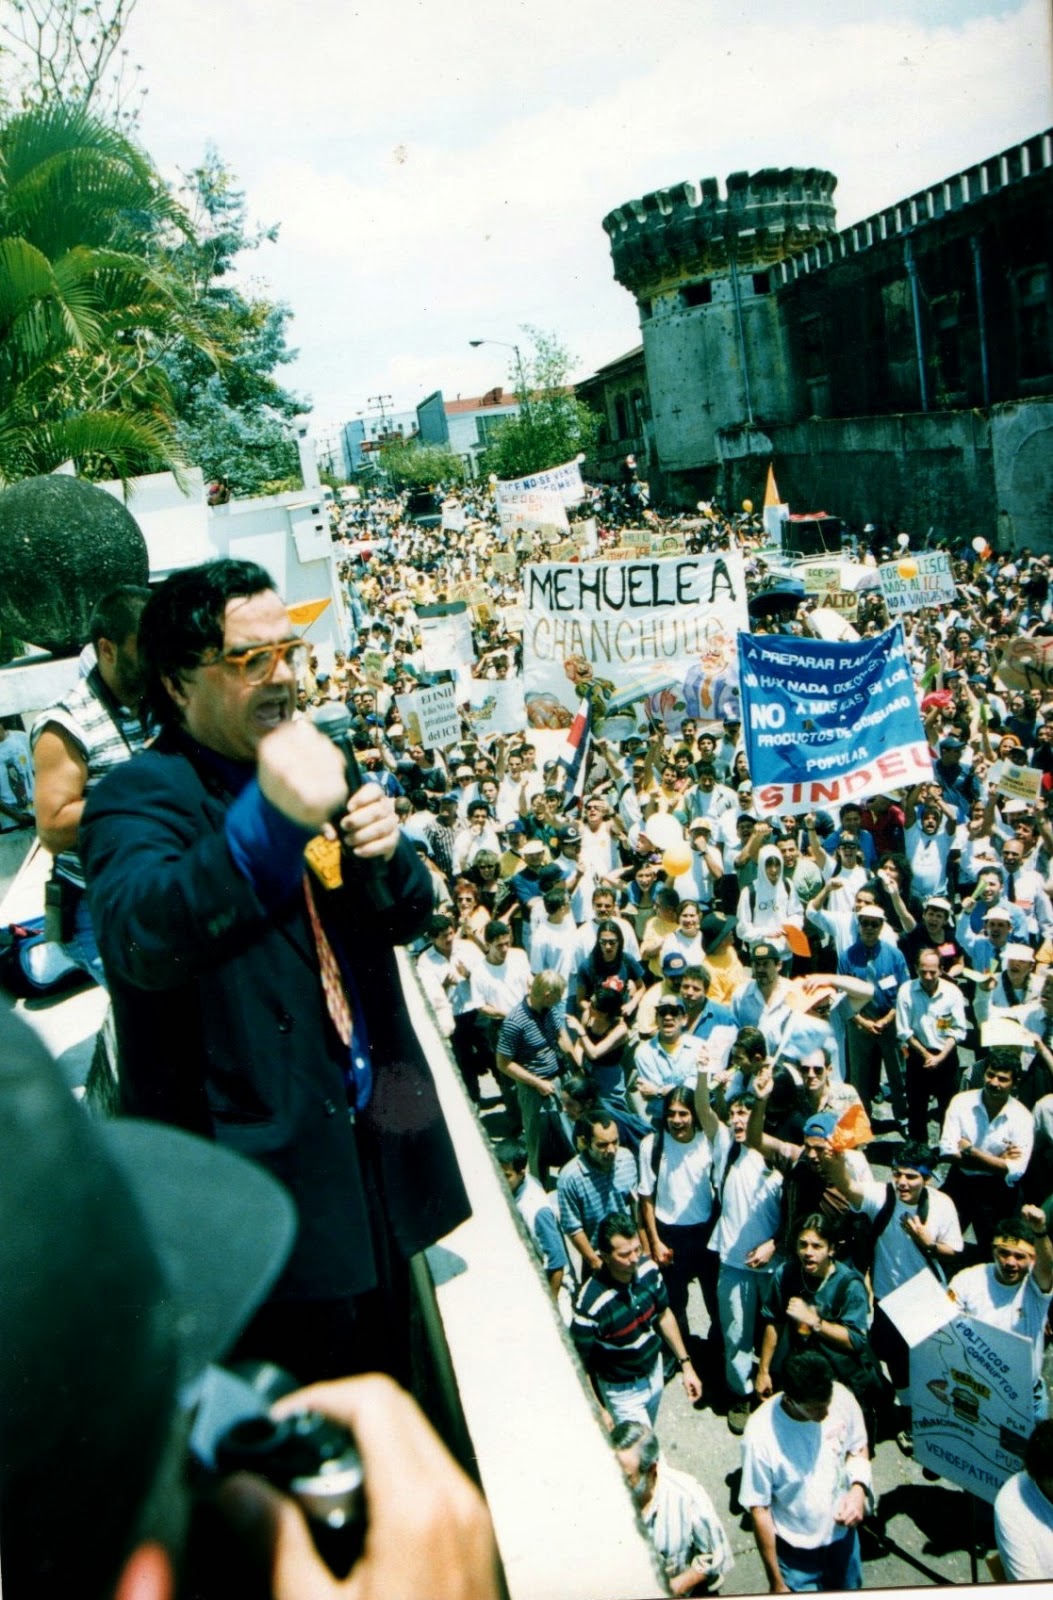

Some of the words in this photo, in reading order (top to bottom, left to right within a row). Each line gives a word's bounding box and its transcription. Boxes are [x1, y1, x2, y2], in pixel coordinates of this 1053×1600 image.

[523, 478, 537, 491] NO
[708, 558, 737, 603] A
[924, 575, 941, 590] ICE
[821, 593, 856, 608] ALTO
[747, 648, 758, 659] A
[761, 649, 835, 670] PREPARAR
[750, 703, 786, 729] NO
[796, 702, 807, 715] A
[810, 700, 838, 715] MAS
[867, 680, 883, 696] EN
[885, 668, 909, 688] LOS
[787, 680, 829, 695] NADA
[428, 730, 440, 741] del
[442, 724, 459, 737] ICE
[758, 728, 834, 747] PRODUCTOS
[836, 727, 853, 739] DE
[852, 695, 912, 732] CONSUMO
[806, 746, 869, 772] POPULAR
[760, 744, 936, 809] SINDEU
[956, 1322, 1010, 1373] POLITICOS
[967, 1346, 1018, 1401] CORRUPTOS
[996, 1449, 1022, 1471] PUS
